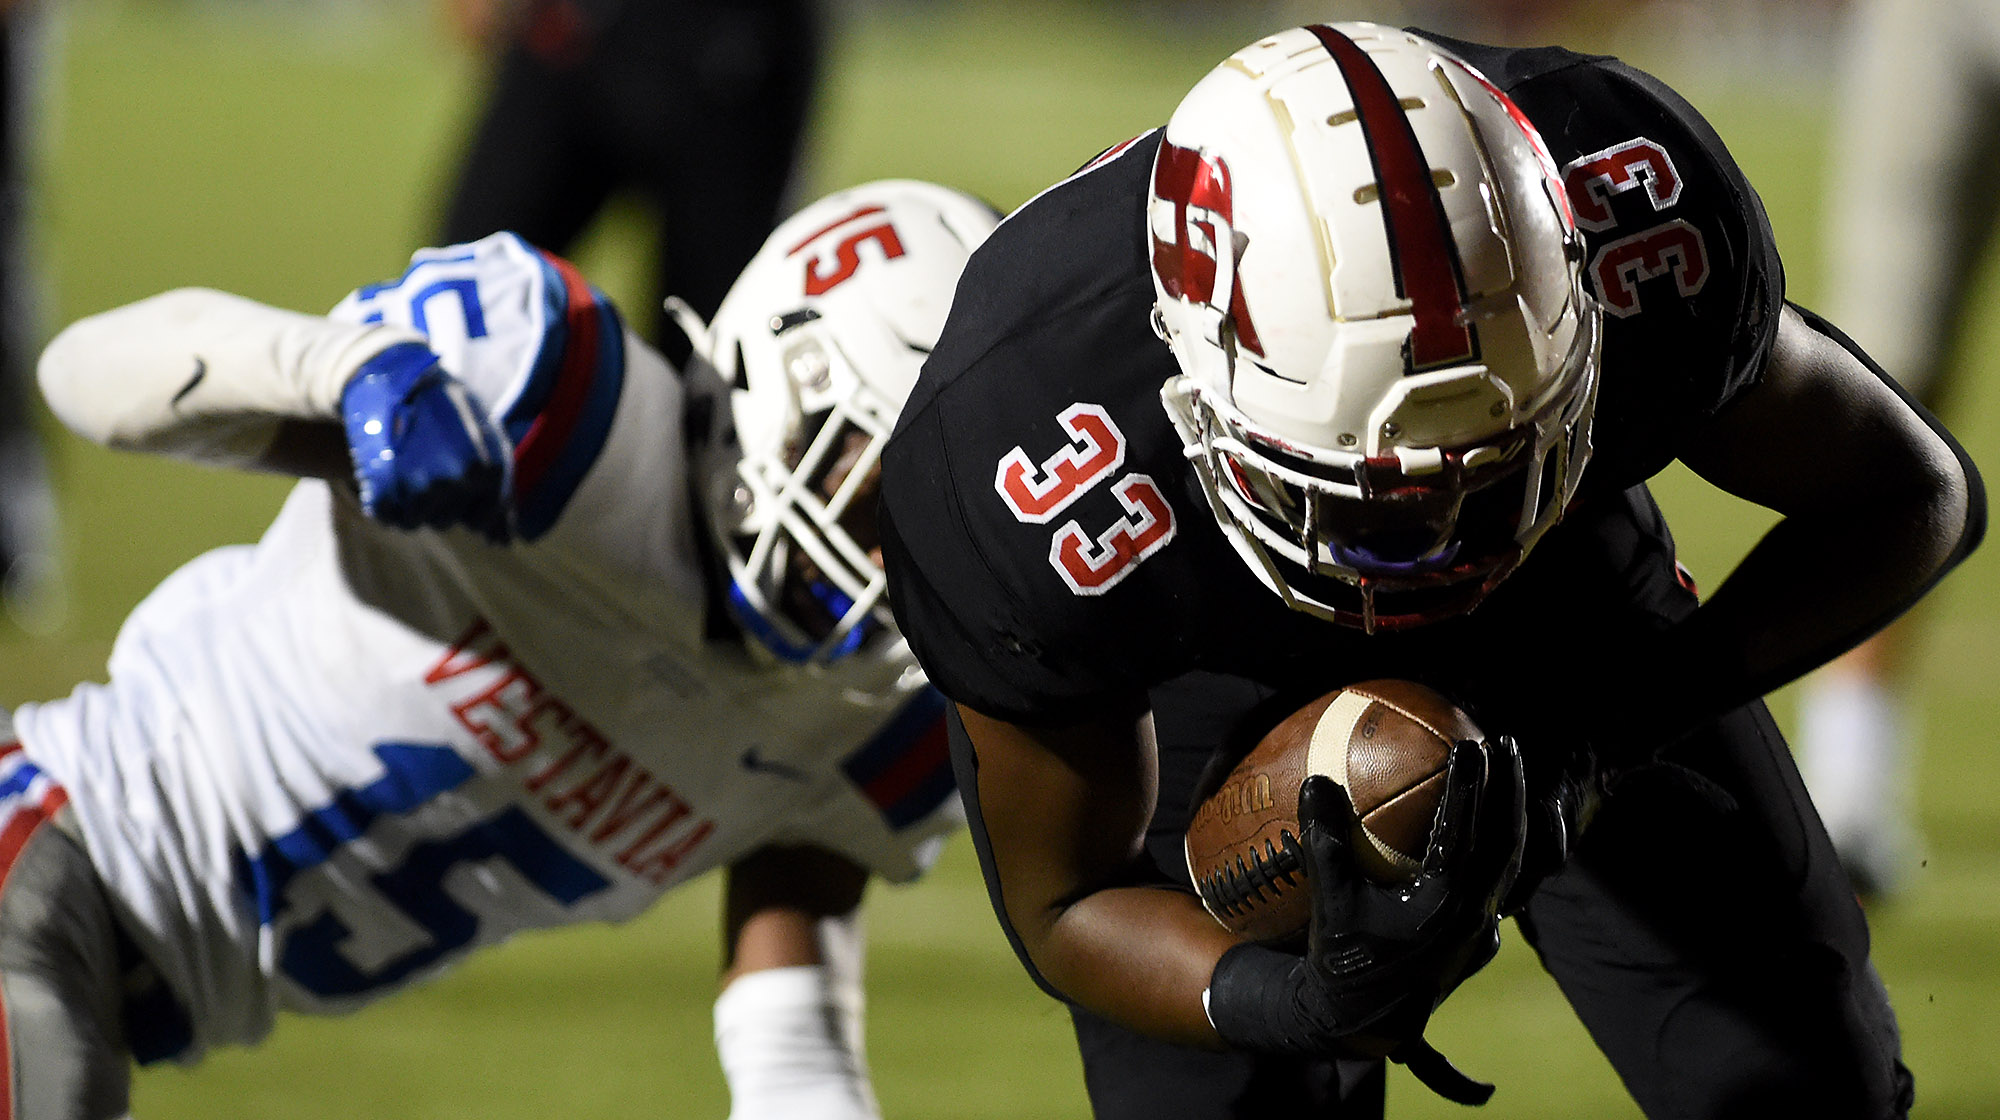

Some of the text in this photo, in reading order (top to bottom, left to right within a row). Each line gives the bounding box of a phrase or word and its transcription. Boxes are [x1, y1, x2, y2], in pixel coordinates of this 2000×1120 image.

[785, 205, 906, 296] 15
[1560, 136, 1710, 319] 33
[994, 402, 1178, 596] 33
[424, 616, 717, 887] VESTAVIA
[236, 742, 616, 997] 15
